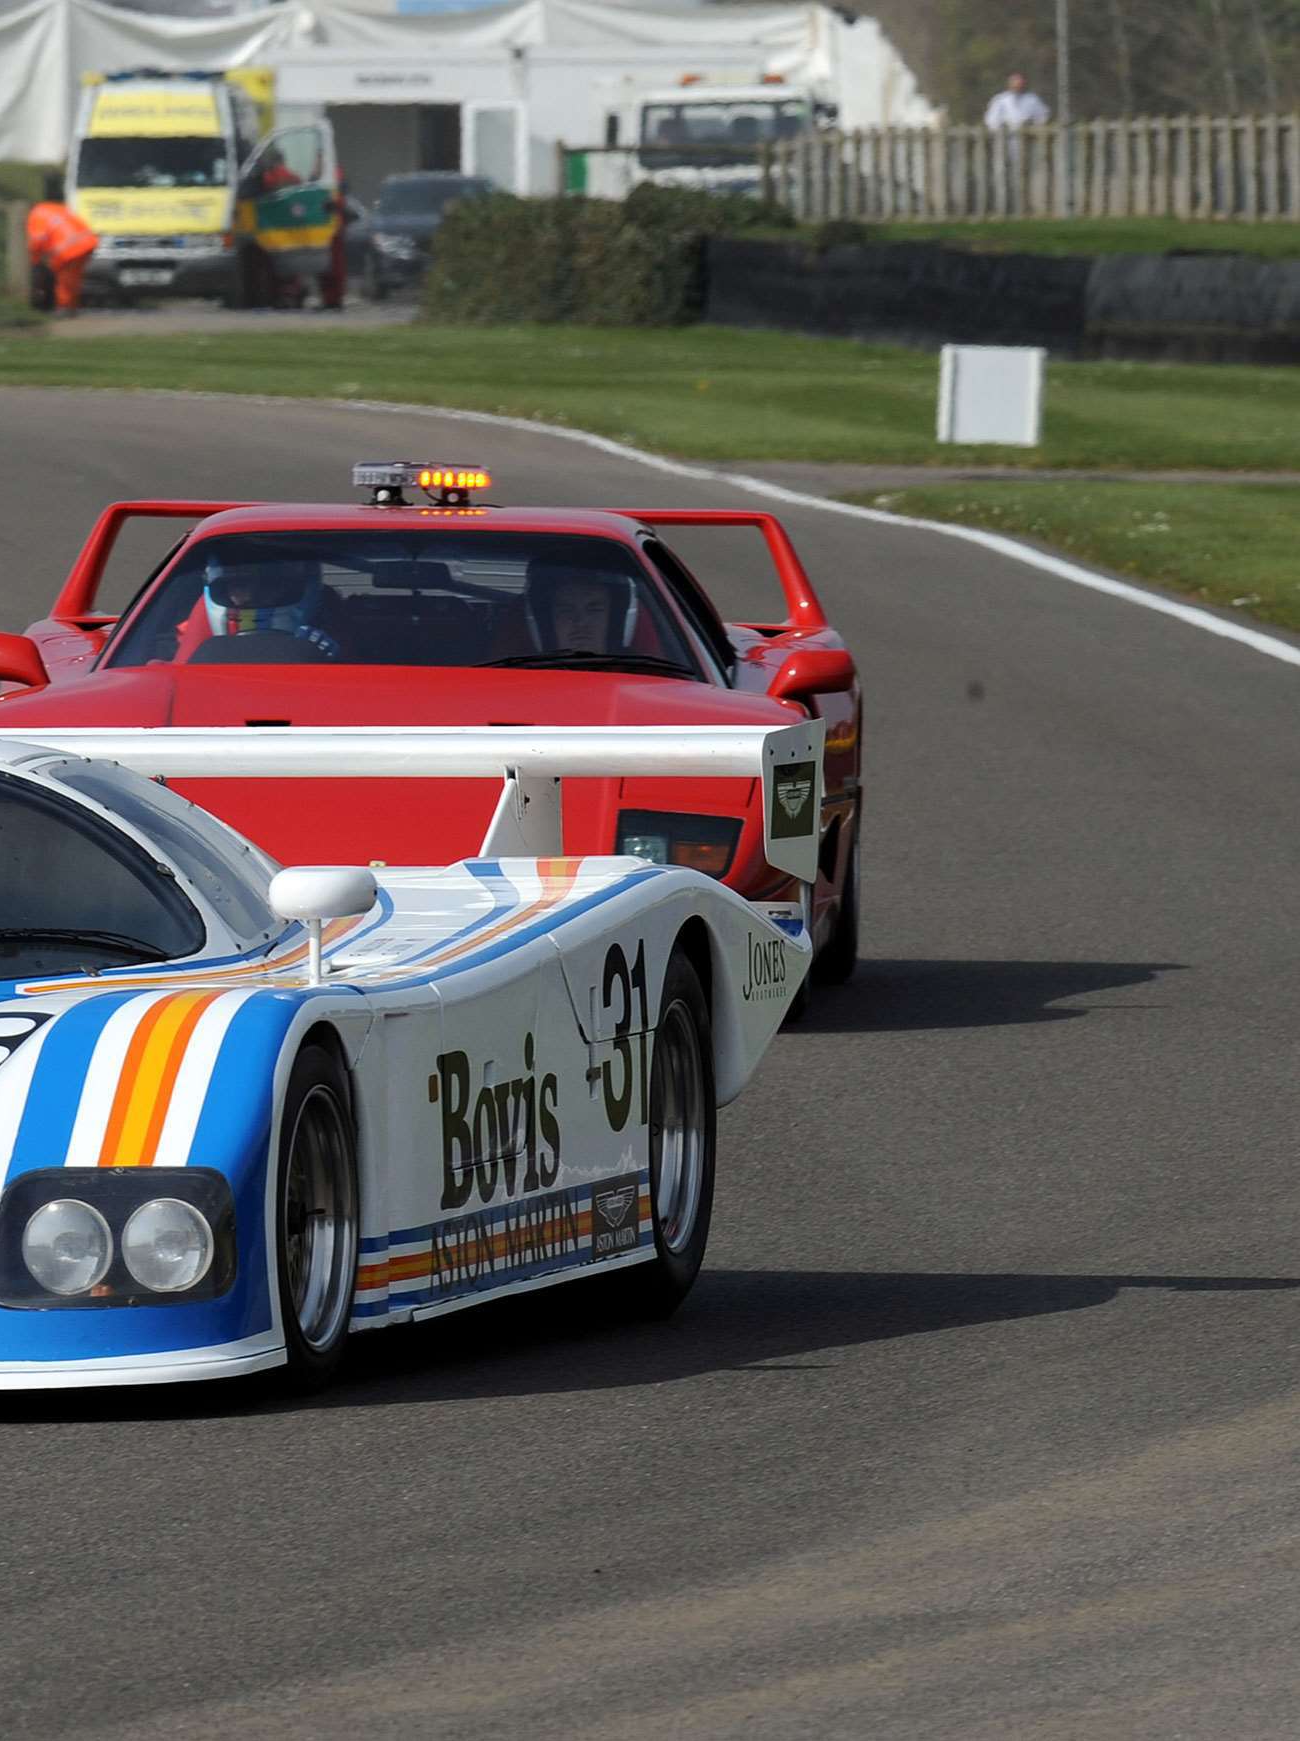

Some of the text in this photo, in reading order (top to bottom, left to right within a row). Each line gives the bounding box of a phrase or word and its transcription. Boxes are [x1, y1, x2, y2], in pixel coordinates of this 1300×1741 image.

[602, 938, 649, 1132] 31
[743, 932, 786, 1000] JONES
[437, 1032, 561, 1210] Bovis
[429, 1187, 580, 1296] ASTON MARTIN
